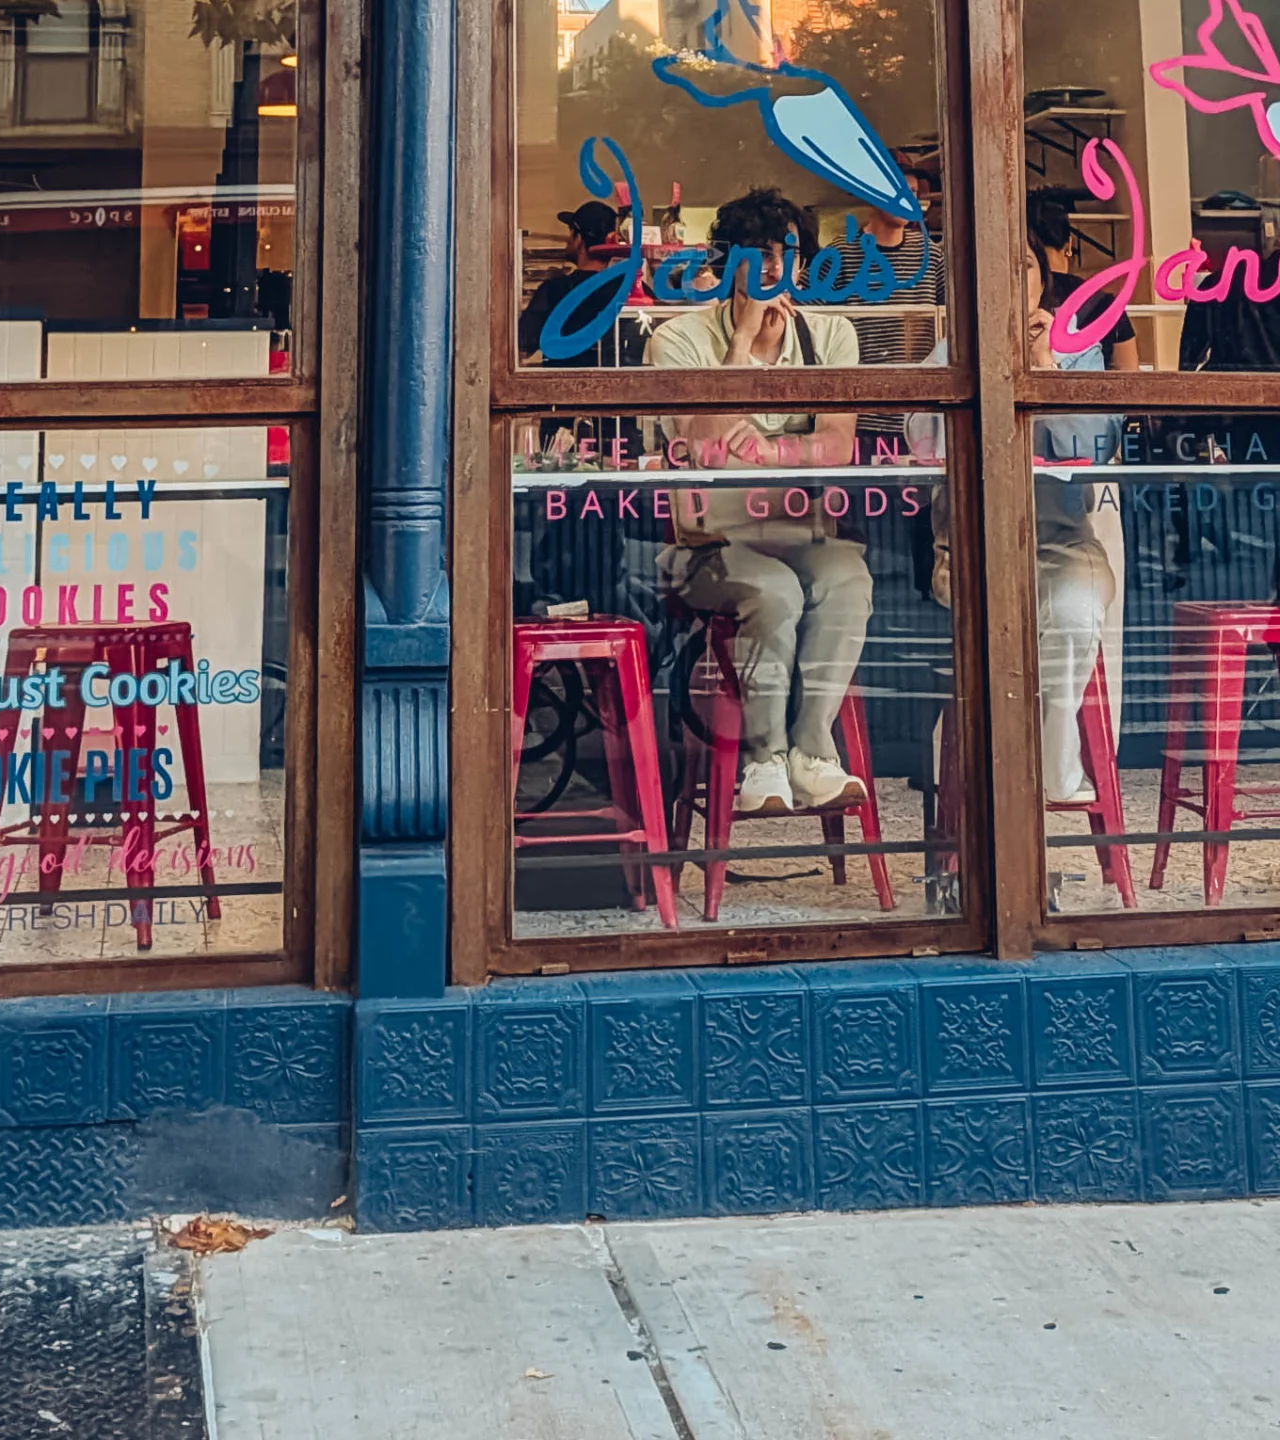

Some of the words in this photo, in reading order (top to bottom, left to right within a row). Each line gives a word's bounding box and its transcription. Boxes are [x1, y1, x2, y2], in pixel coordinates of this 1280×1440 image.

[539, 136, 915, 359] Janie's
[546, 488, 710, 520] BAKED
[746, 486, 920, 518] GOODS
[80, 659, 261, 707] Cookies
[84, 748, 173, 802] PIES
[106, 898, 208, 928] DAILY
